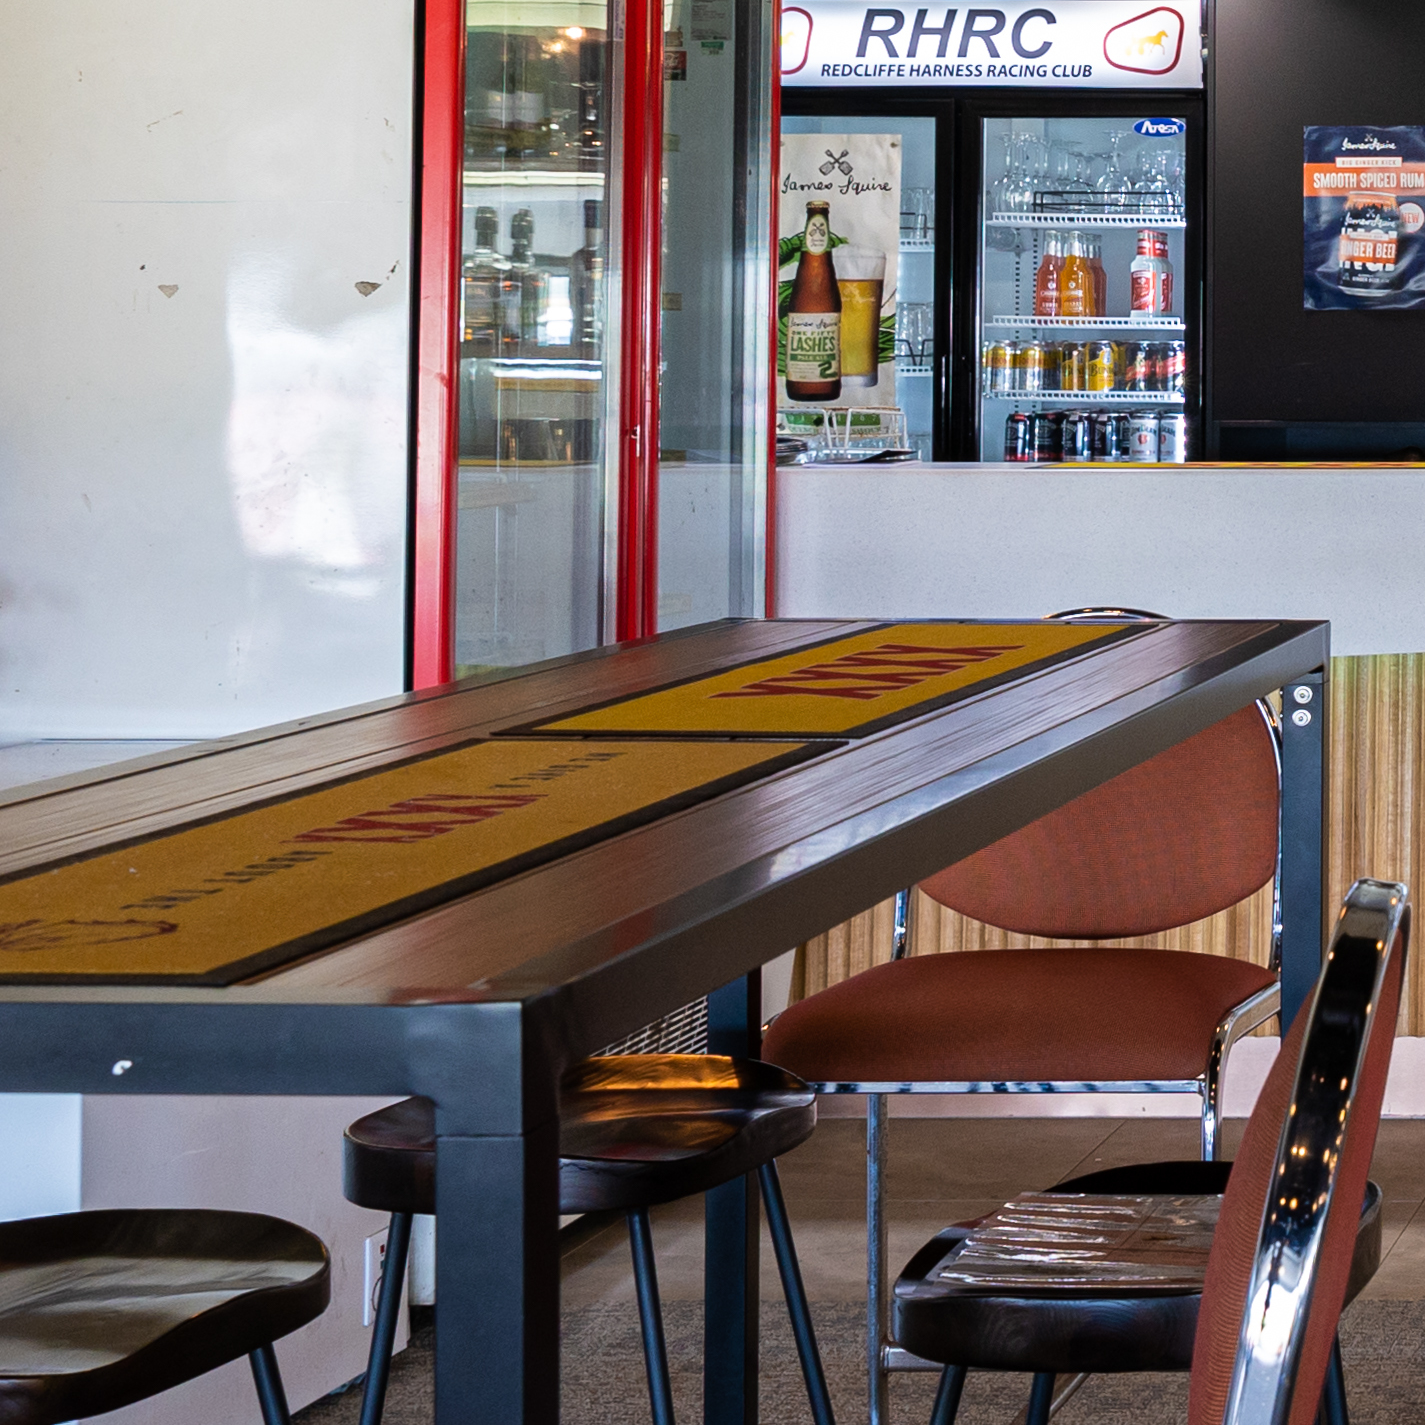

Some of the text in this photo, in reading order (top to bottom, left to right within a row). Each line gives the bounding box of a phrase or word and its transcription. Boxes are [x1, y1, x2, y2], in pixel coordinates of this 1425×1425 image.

[855, 8, 1057, 59] RHRC
[821, 64, 1093, 78] REDCLIFFE HARNESS RACING CLUB
[782, 173, 892, 195] James Squire
[1313, 173, 1425, 188] SMOOTH SPICED RUM
[790, 336, 836, 352] LASHES
[704, 643, 1027, 700] XXXX
